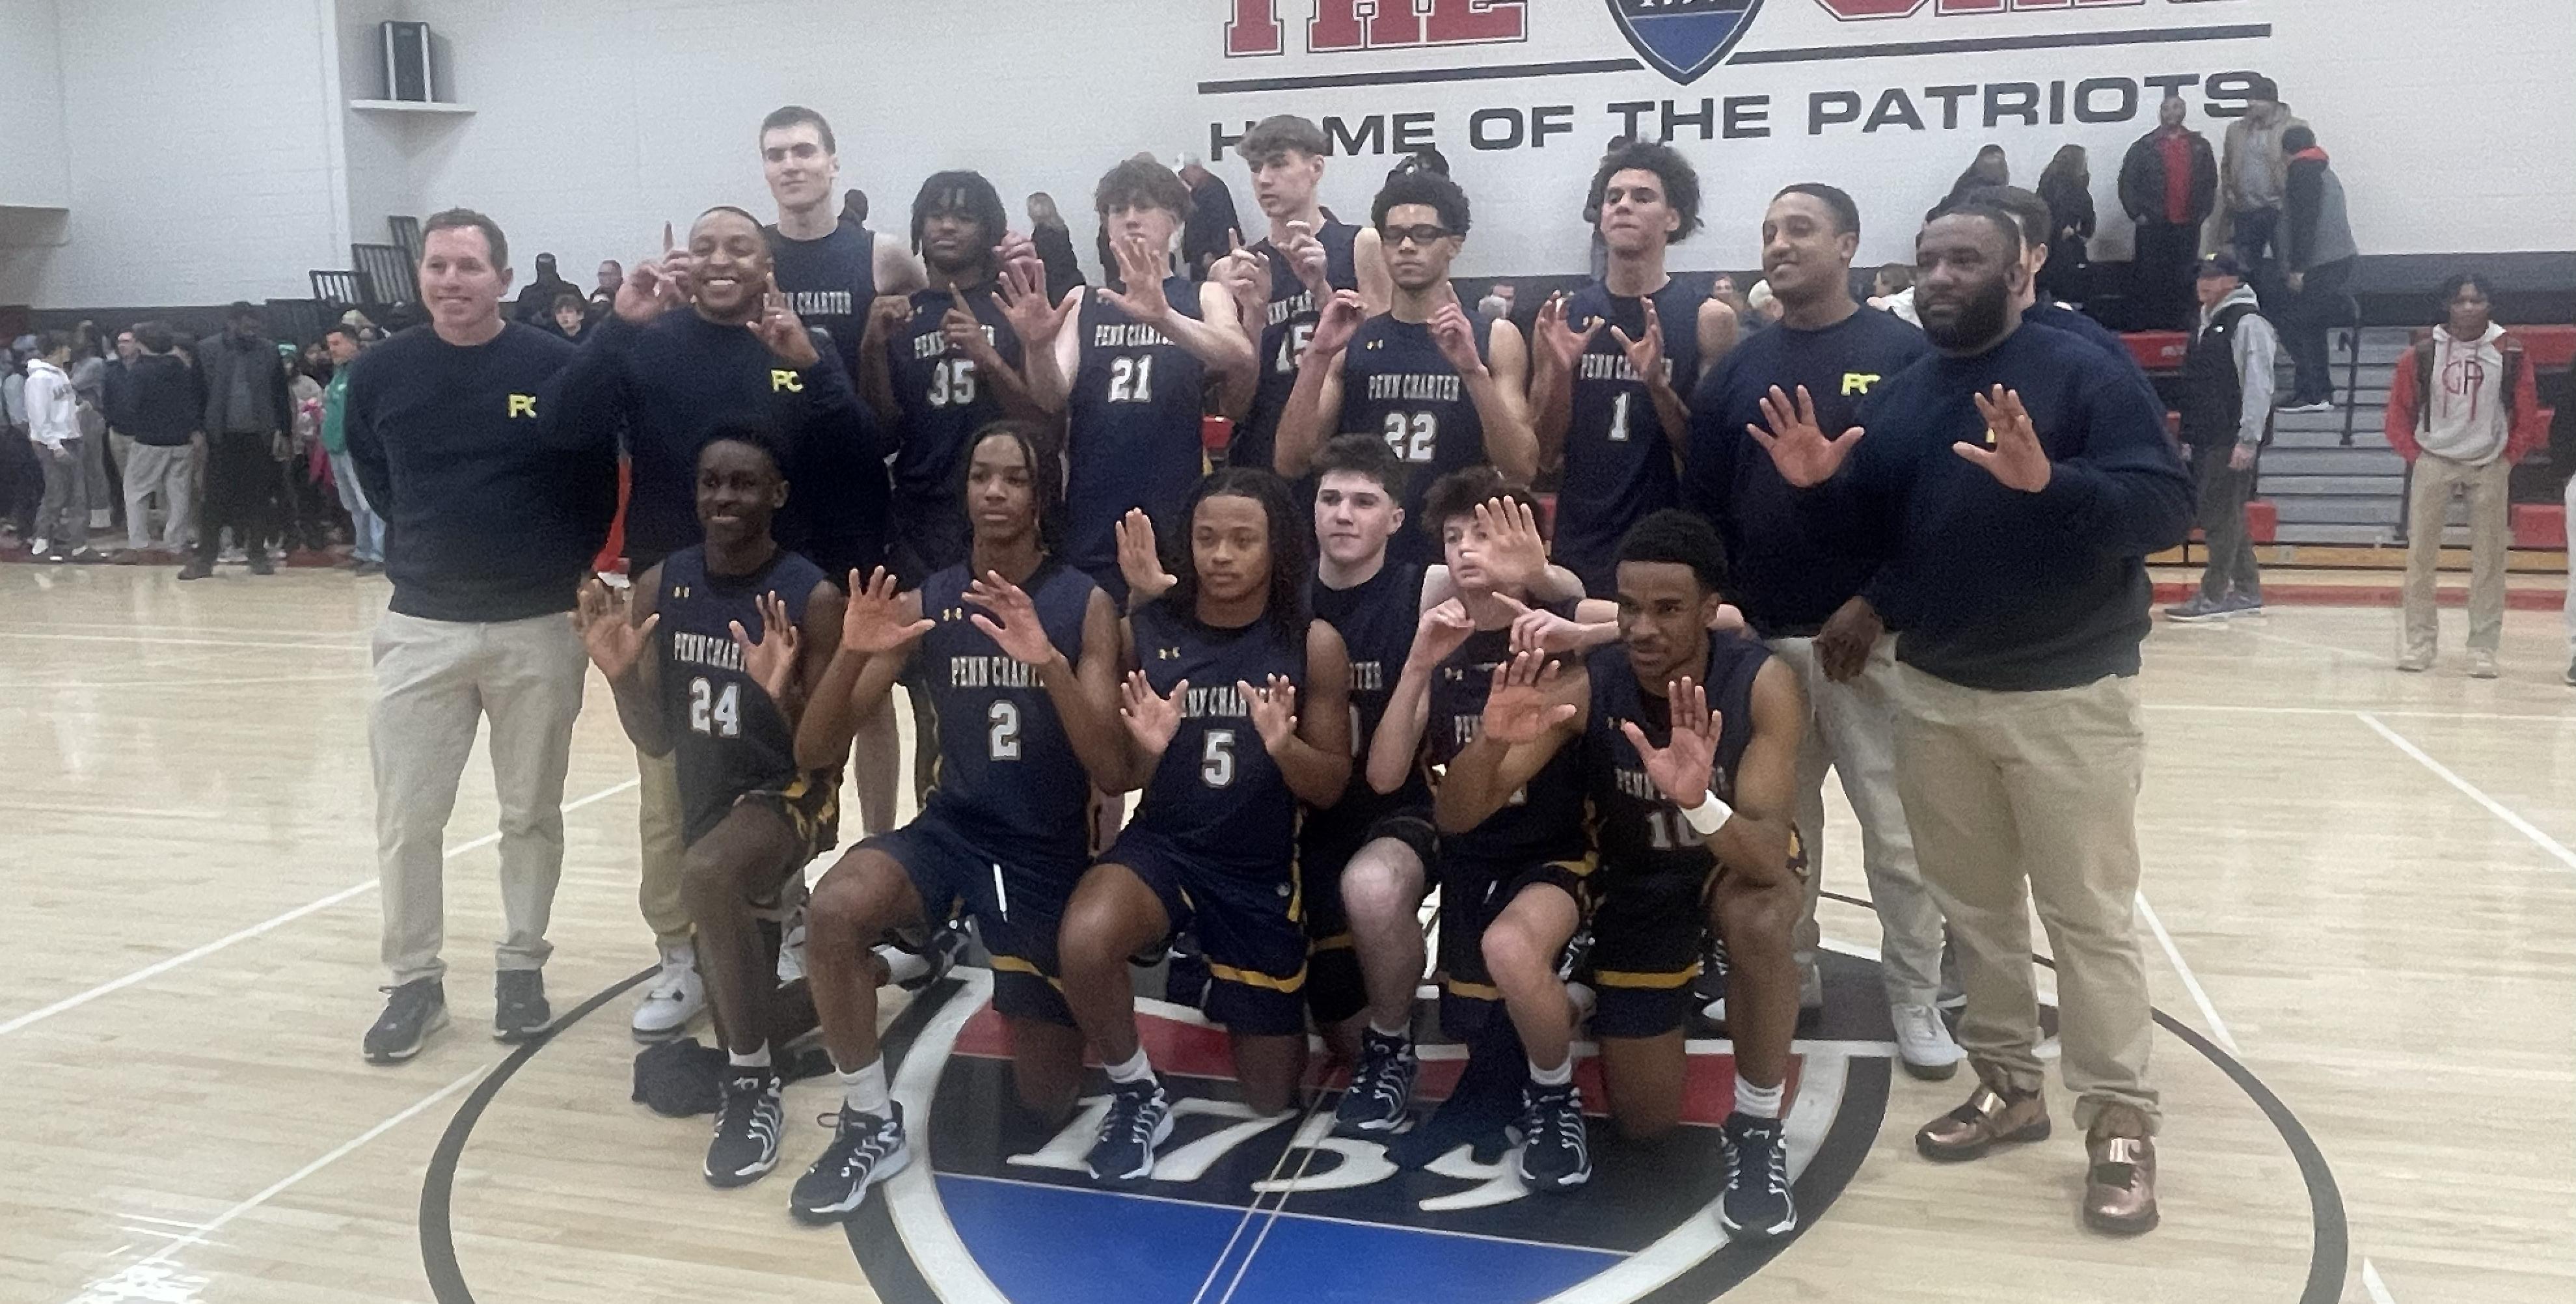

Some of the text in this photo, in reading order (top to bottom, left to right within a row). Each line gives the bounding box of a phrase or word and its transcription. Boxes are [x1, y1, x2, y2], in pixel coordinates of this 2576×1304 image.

[1211, 71, 2263, 161] HME OF THE PATRIOTS
[771, 370, 804, 392] PC
[928, 359, 976, 407] 35
[1108, 355, 1152, 402] 21
[1368, 374, 1459, 401] PENN CHARTER
[1384, 411, 1436, 461] 22
[1609, 392, 1630, 441] 1
[951, 657, 988, 687] PENN
[690, 677, 740, 738] 24
[988, 700, 1022, 761] 2
[1202, 729, 1235, 788] 5
